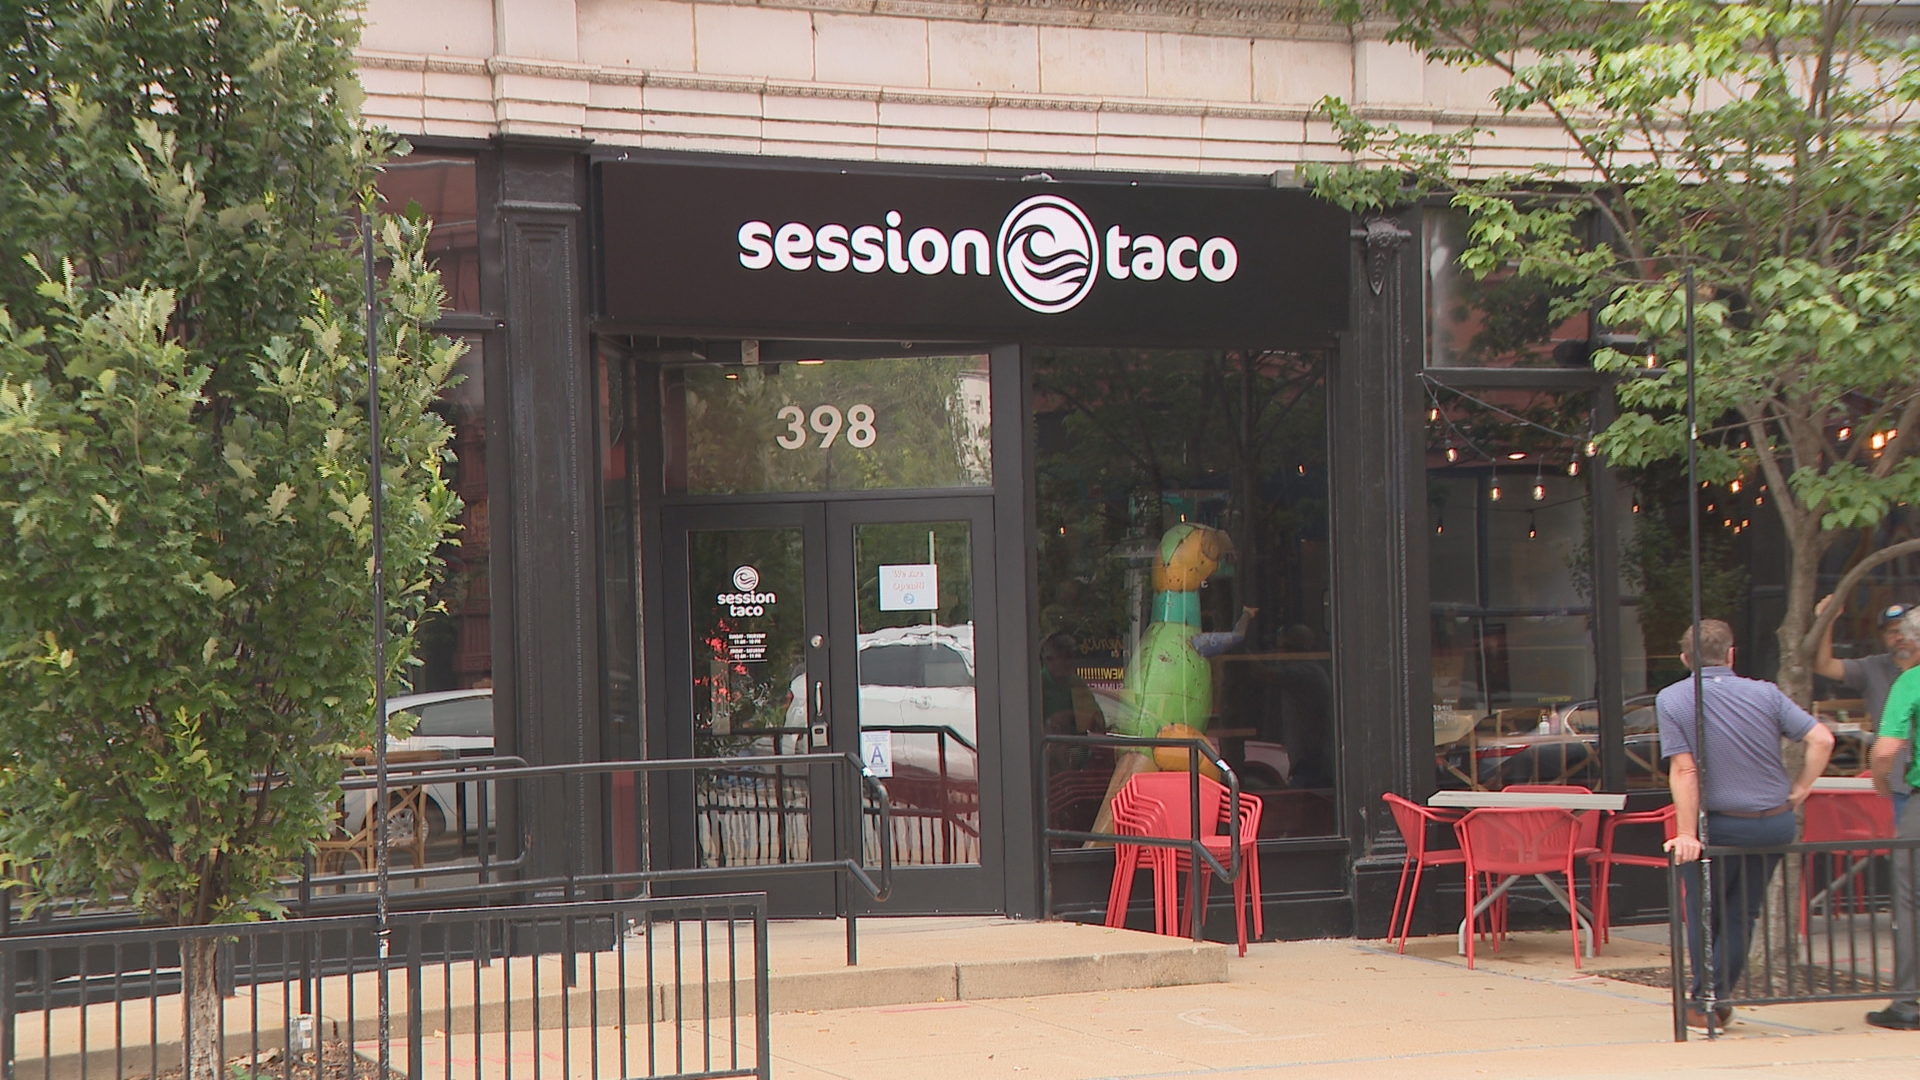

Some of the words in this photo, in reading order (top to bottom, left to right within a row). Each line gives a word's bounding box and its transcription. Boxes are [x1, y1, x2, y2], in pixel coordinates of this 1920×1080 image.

[738, 210, 991, 275] session
[1106, 224, 1238, 282] taco
[776, 404, 877, 450] 398
[717, 590, 776, 604] session
[730, 604, 764, 617] taco
[871, 746, 884, 764] A
